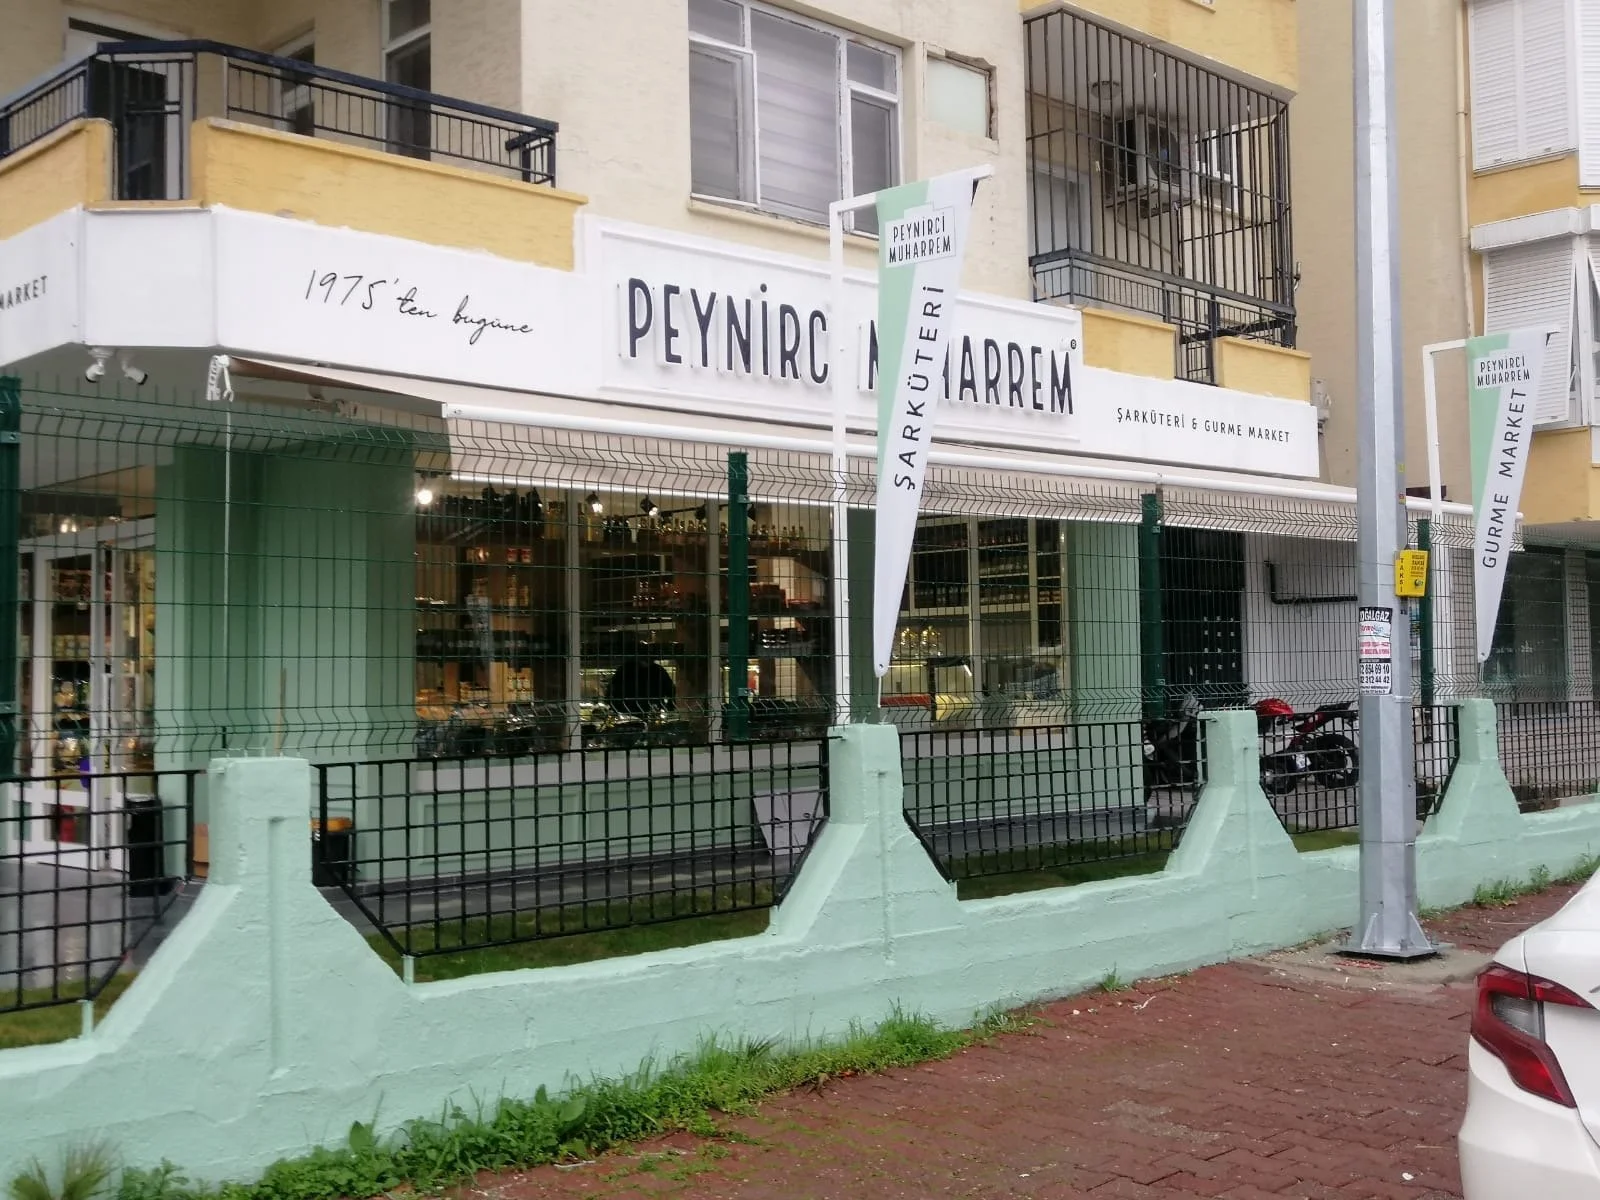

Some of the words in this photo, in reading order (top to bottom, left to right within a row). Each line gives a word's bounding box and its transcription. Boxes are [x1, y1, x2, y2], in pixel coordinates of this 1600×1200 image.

[888, 235, 951, 263] MUHARREM
[892, 211, 945, 243] PEYNİRCİ
[305, 269, 437, 318] 1975'ten
[452, 294, 533, 345] bugüne
[628, 277, 829, 384] PEYNİRC
[894, 286, 945, 491] ŞARKÜTERİ
[1477, 368, 1530, 387] MUHARREM
[1116, 407, 1186, 429] ŞARKÜTERİ
[1191, 417, 1199, 435] &
[1204, 419, 1243, 437] GURME
[1248, 426, 1291, 443] MARKET
[1482, 492, 1509, 569] GURME
[1498, 387, 1527, 478] MARKET
